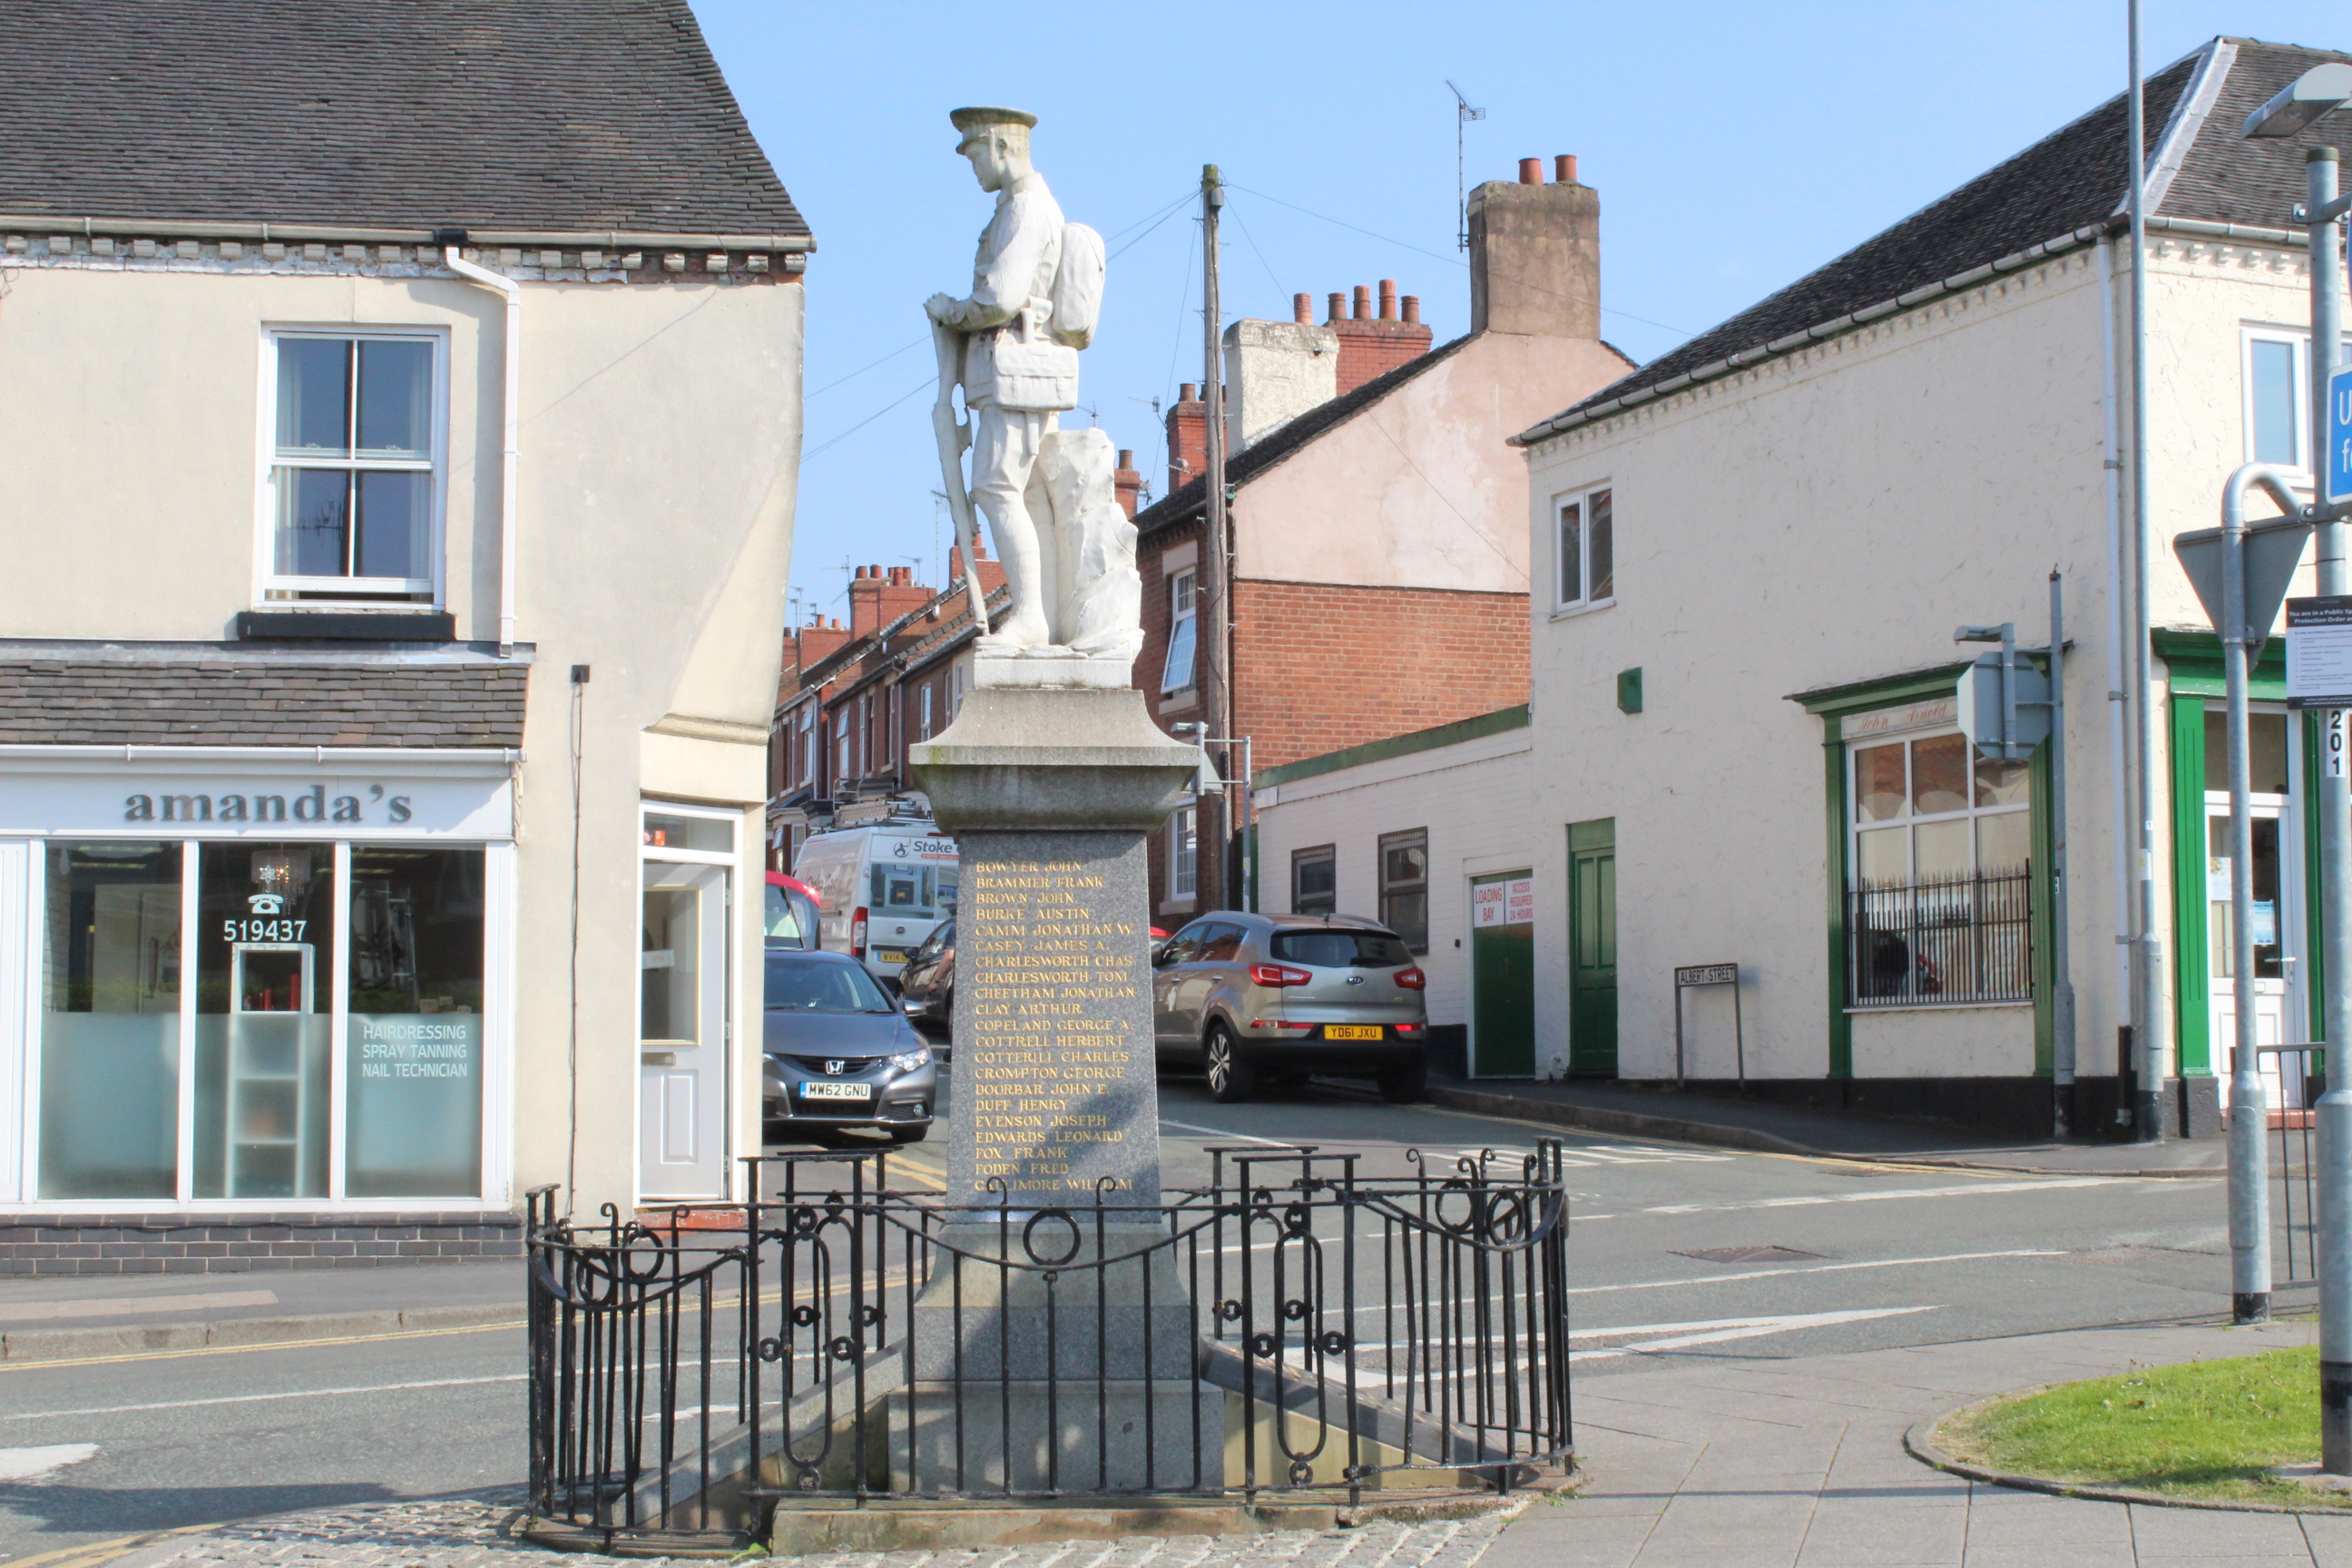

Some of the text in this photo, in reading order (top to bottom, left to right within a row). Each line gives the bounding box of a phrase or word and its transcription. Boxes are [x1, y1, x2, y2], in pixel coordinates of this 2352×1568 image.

[1859, 703, 1947, 730] John Arnold
[125, 784, 413, 824] amanda's
[913, 840, 953, 854] Stoke
[976, 861, 1083, 873] BOWYER JOHN
[976, 877, 1104, 888] BRAMMER FRANK
[1513, 882, 1531, 894] ACCESS
[976, 893, 1074, 904] BROWN JOHN
[1475, 887, 1503, 904] LOADING
[1510, 895, 1533, 907] REQUIRED
[976, 908, 1090, 920] BURKE AUSTIN
[1483, 907, 1494, 921] BAY
[1517, 907, 1533, 920] HOURS
[223, 919, 308, 942] 519437
[975, 925, 1026, 936] CAMM
[1033, 924, 1112, 936] JONATHAN
[975, 940, 1025, 952] CASEY
[1034, 940, 1090, 951] JAMES
[975, 956, 1090, 968] CHARLESWORTH
[975, 971, 1129, 984] CHARLESWORTH TOM
[1681, 966, 1734, 984] ALBERT STREET
[975, 987, 1135, 999] CHEETHAM JONATHAN
[975, 1004, 1083, 1015] CLAY ARTHUR
[975, 1020, 1052, 1031] COPELAND
[1056, 1020, 1113, 1031] GEORGE
[363, 1024, 467, 1040] HAIRDRESSING
[1331, 1026, 1377, 1038] YD61 JXU
[975, 1035, 1125, 1047] COTTRELL HERBERT
[363, 1044, 467, 1059] SPRAY TANNING
[975, 1052, 1130, 1063] COTTERILL CHARLES
[362, 1063, 468, 1078] NAIL TECHNICIAN
[975, 1067, 1124, 1079] CROMPTON GEORGE
[808, 1083, 868, 1097] MW62 GNU
[975, 1083, 1044, 1095] DOORBAR
[1051, 1083, 1091, 1095] JOHN
[975, 1100, 1069, 1111] DUFF HENRY
[975, 1115, 1107, 1127] EVENSON JOSEPH
[975, 1132, 1123, 1143] EDWARDS LEONARD
[975, 1147, 1068, 1159] FOX FRANK
[975, 1163, 1069, 1175] FODEN FRED
